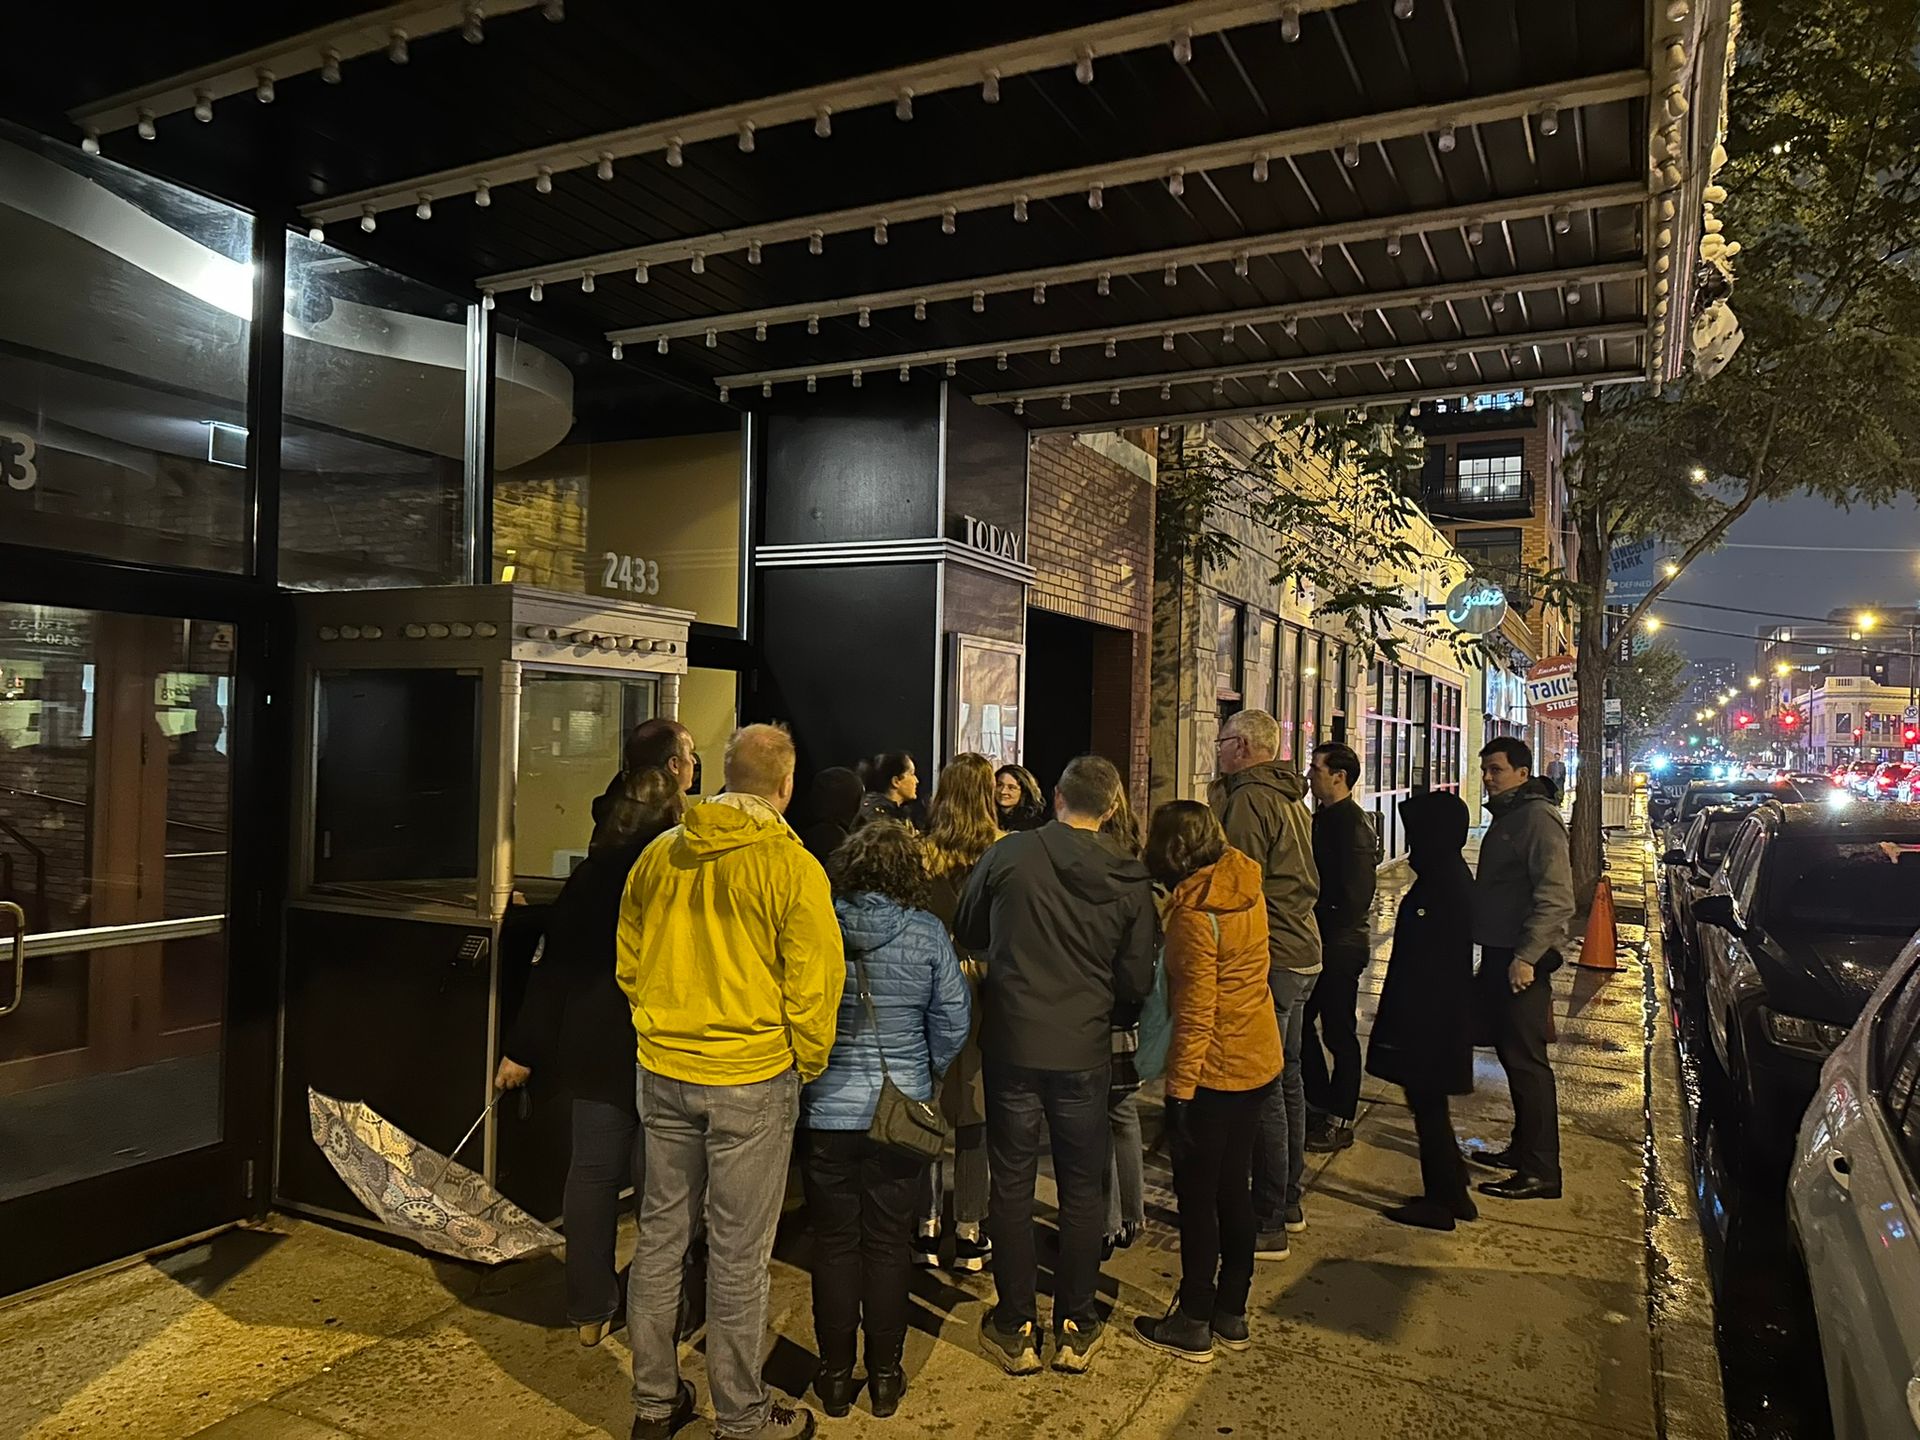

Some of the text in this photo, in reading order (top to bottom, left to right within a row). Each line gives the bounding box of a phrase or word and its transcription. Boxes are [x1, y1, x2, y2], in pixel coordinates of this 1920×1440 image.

[0, 432, 37, 490] 3
[964, 514, 1021, 562] TODAY
[1610, 534, 1632, 550] AKE
[1609, 538, 1655, 561] LINCOLN
[603, 551, 660, 596] 2433
[1612, 555, 1644, 573] PARK
[1619, 580, 1652, 589] DEFINED
[1621, 639, 1629, 661] PARK
[1546, 698, 1578, 712] STREE
